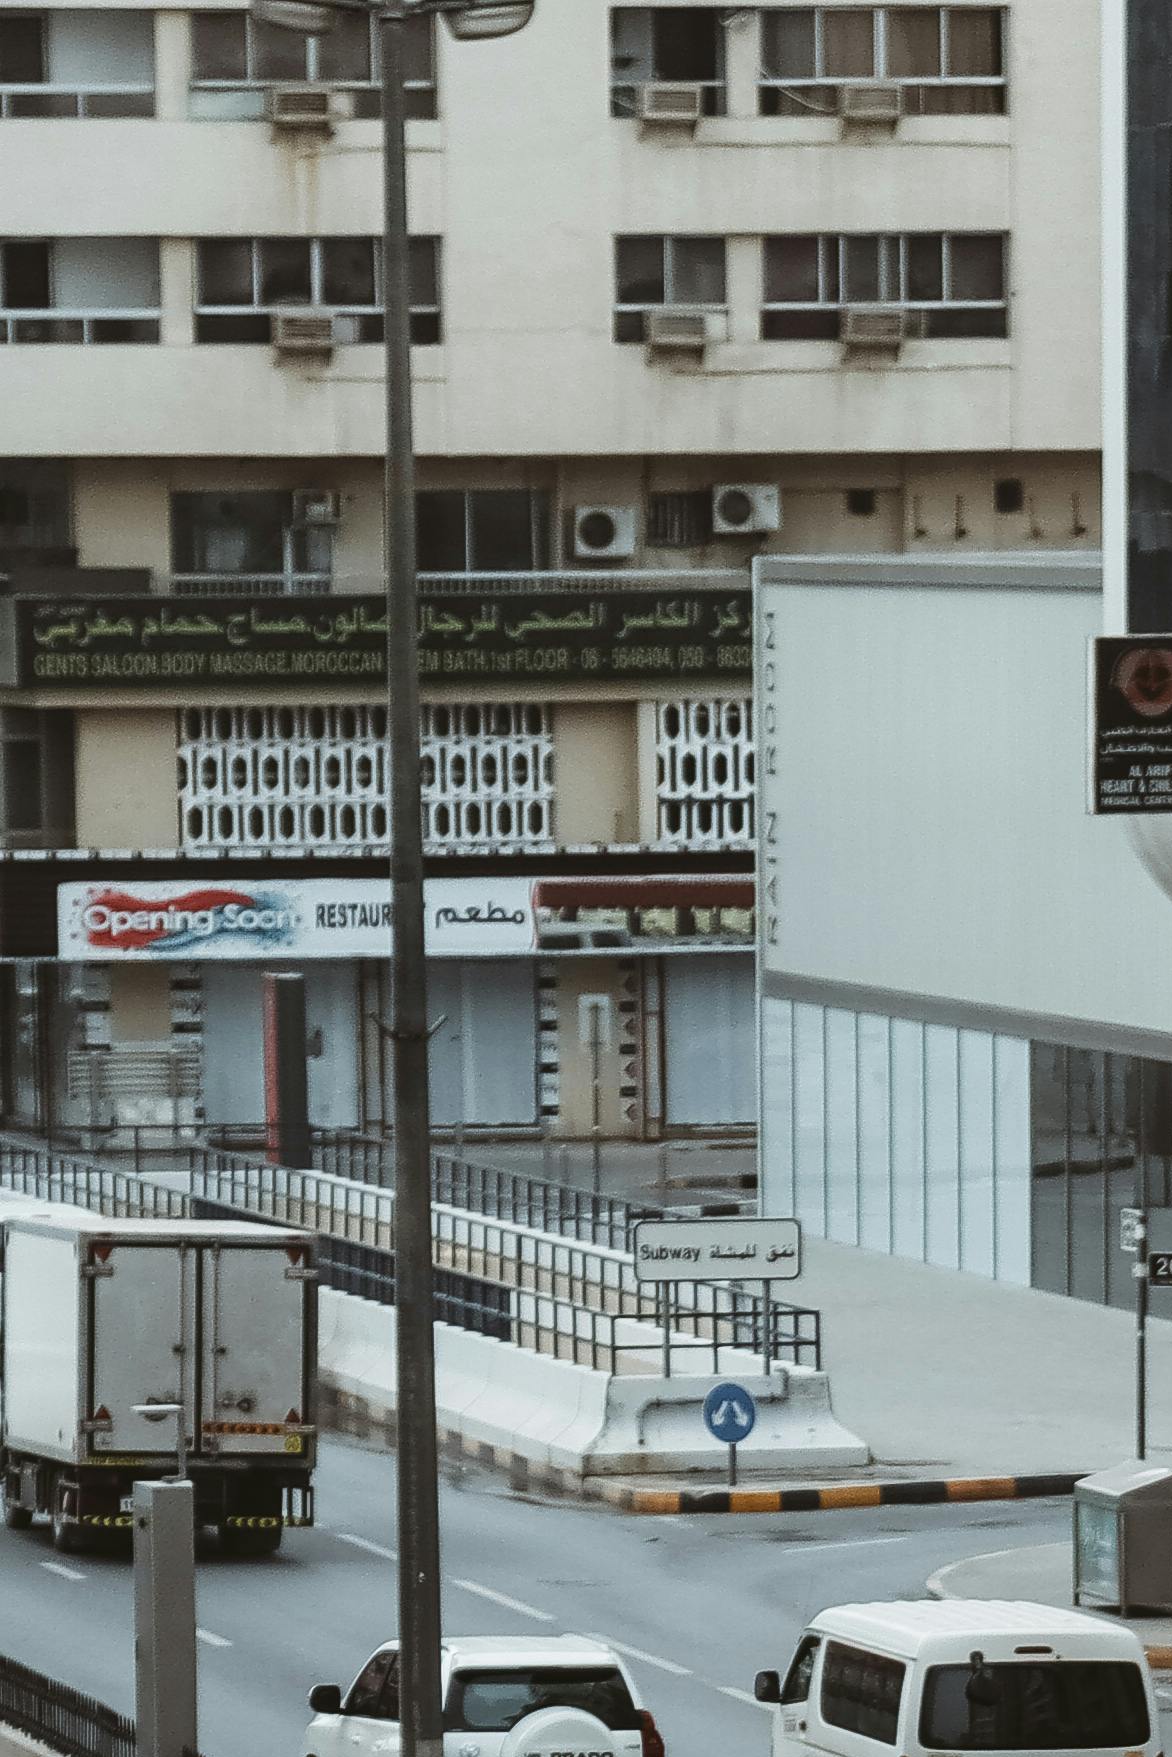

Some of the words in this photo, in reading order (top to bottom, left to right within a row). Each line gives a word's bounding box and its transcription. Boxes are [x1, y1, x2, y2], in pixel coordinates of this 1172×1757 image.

[708, 600, 752, 637] ركز
[33, 653, 87, 677] GENTS
[291, 650, 382, 673] MOROCCAN
[1100, 779, 1136, 794] HEART
[82, 905, 214, 938] Opening
[219, 903, 299, 932] Soon
[315, 903, 393, 929] RESTAUR
[434, 901, 526, 928] مطعم
[639, 1243, 701, 1263] Subway
[766, 1243, 795, 1263] نفق
